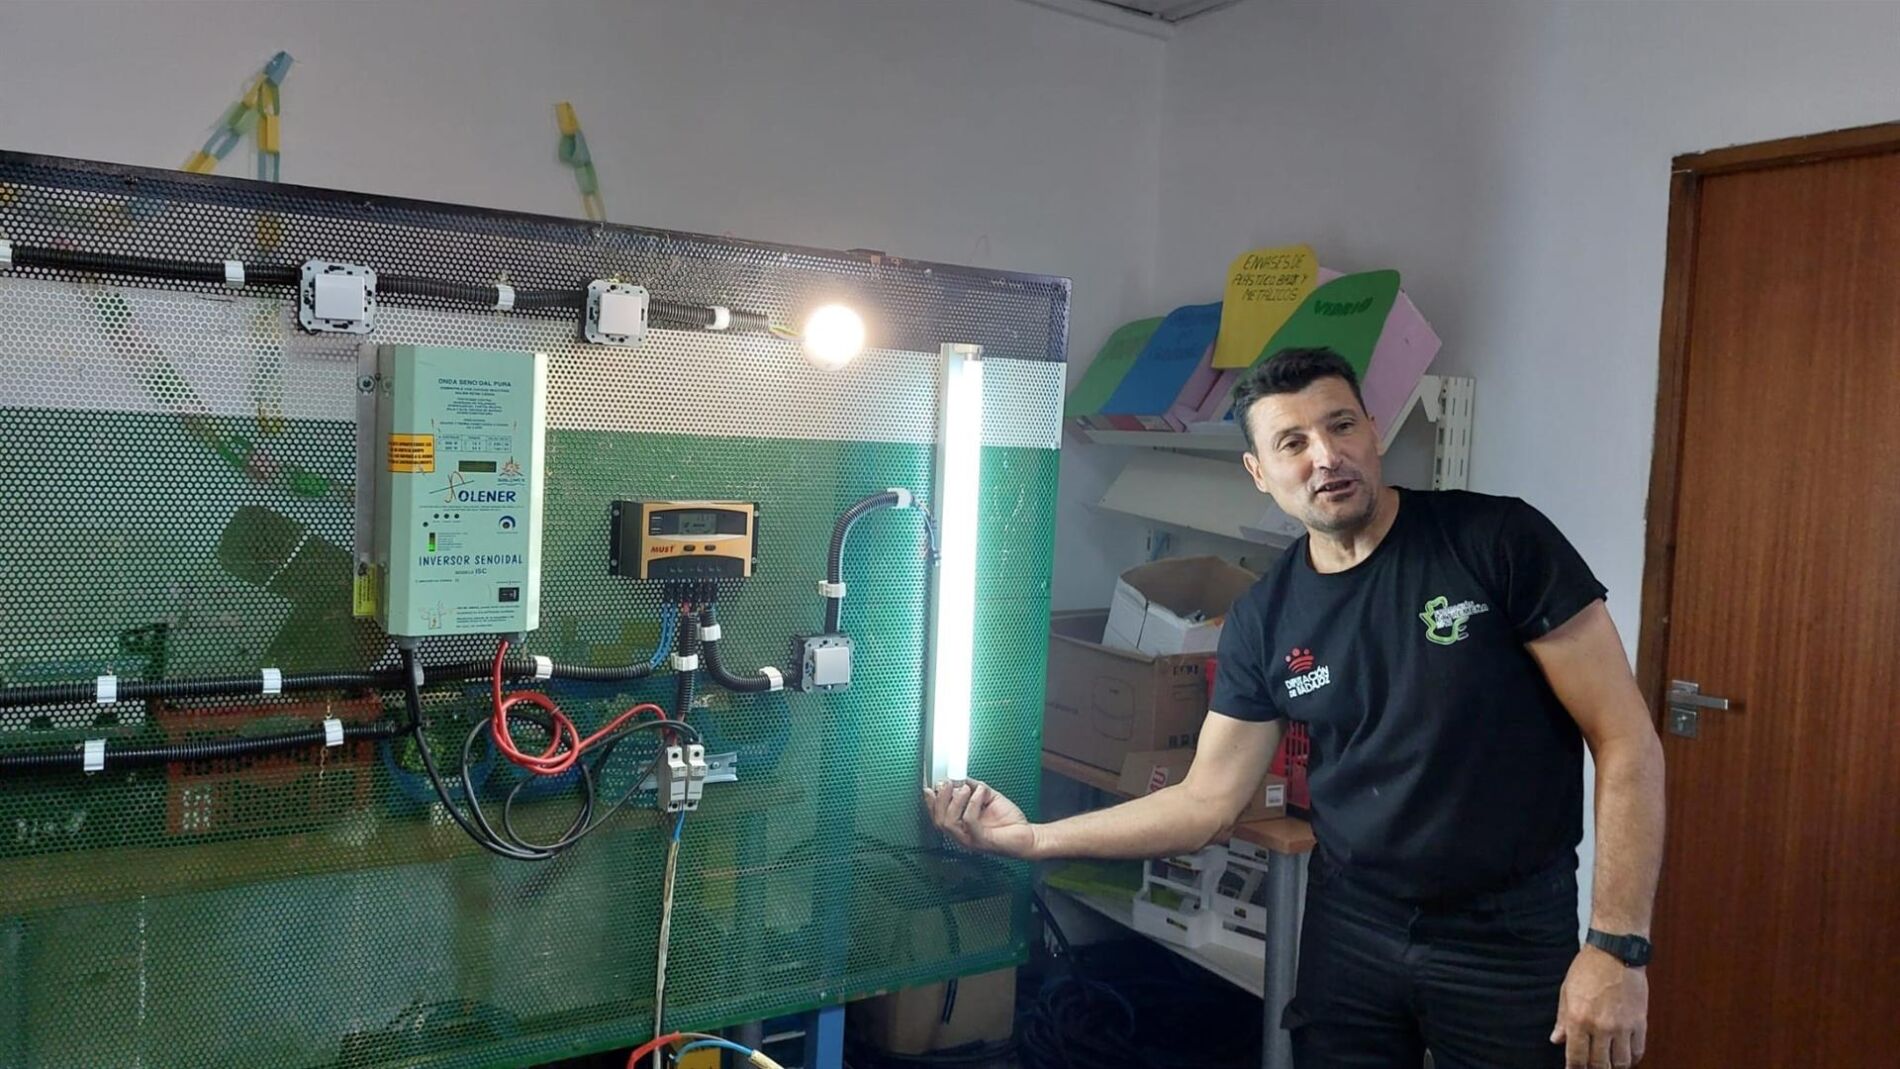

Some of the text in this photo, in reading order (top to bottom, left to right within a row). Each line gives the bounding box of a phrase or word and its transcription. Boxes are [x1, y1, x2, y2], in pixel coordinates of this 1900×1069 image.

[651, 545, 674, 553] MUST
[419, 555, 523, 566] INVERSOR SENOIDAL
